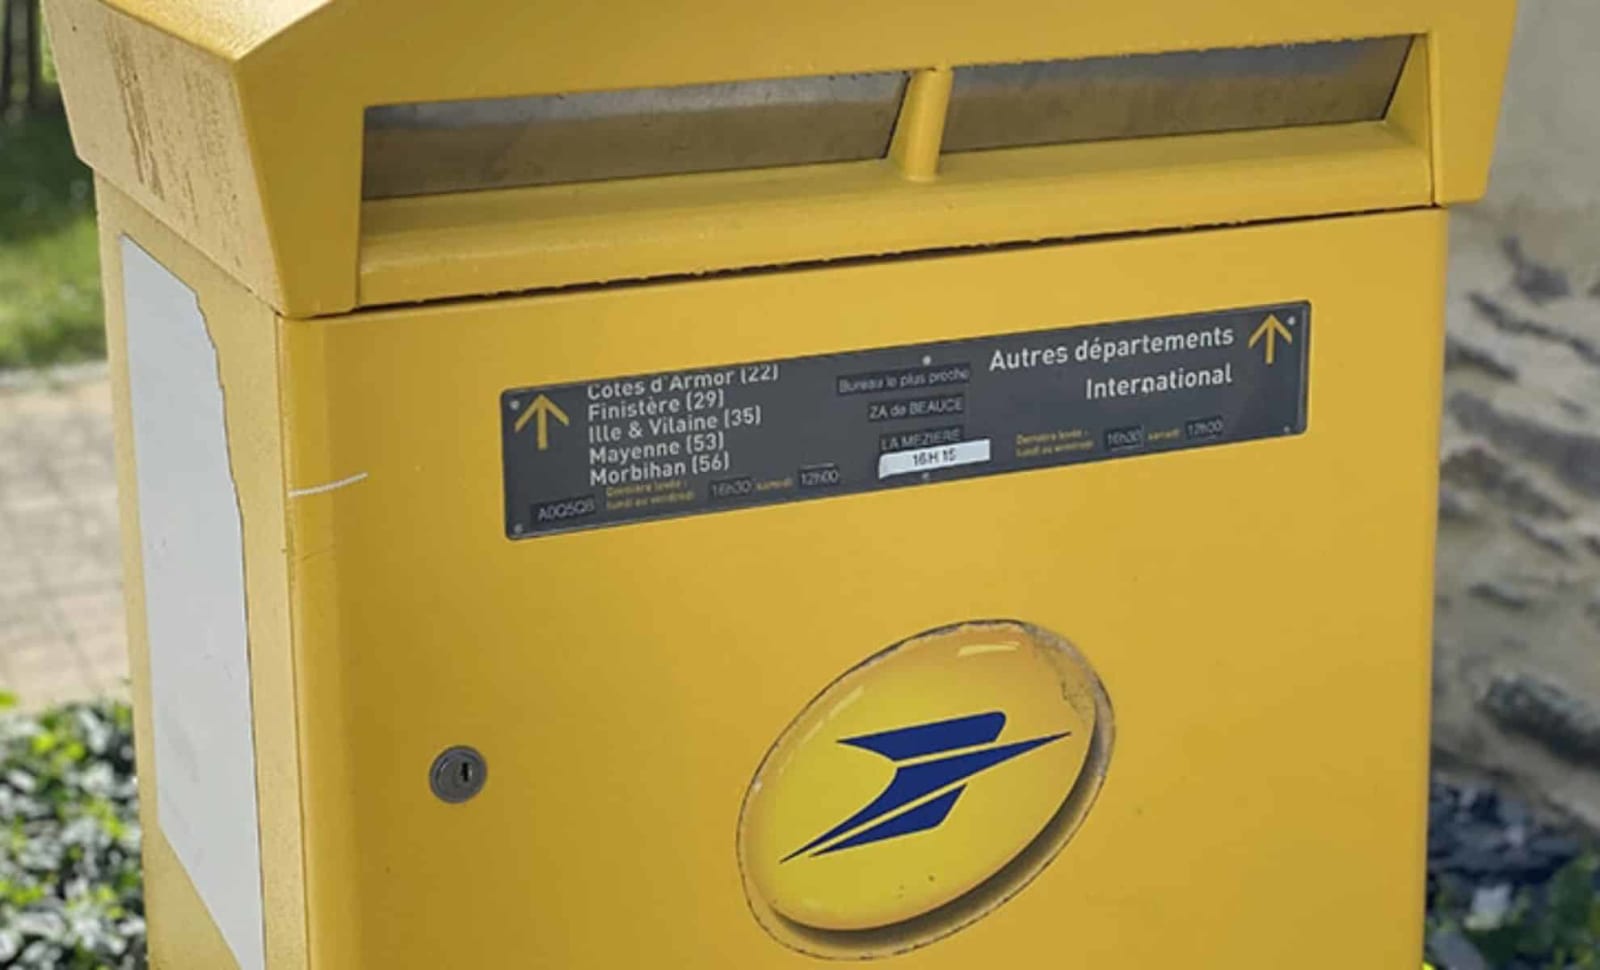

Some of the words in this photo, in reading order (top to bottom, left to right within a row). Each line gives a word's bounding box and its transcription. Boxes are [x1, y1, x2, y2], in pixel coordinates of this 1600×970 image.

[988, 348, 1068, 372] Autres
[1074, 326, 1235, 364] départements
[740, 363, 780, 385] (22)
[839, 376, 883, 394] Bureau
[886, 376, 898, 388] le
[900, 372, 925, 390] plus
[929, 366, 970, 386] proche
[1085, 363, 1233, 400] International
[588, 398, 681, 422] Finistère
[686, 388, 725, 411] (29)
[869, 404, 888, 419] ZA
[891, 405, 907, 417] de
[909, 397, 964, 415] BEAUCE
[589, 426, 622, 444] Ille
[628, 421, 643, 439] &
[648, 415, 719, 437] Vilaine
[724, 404, 763, 428] (35)
[589, 441, 681, 467] Mayenne
[686, 431, 725, 455] (53)
[881, 439, 899, 451] LA
[590, 462, 687, 487] Morbihan
[691, 451, 731, 475] (56)
